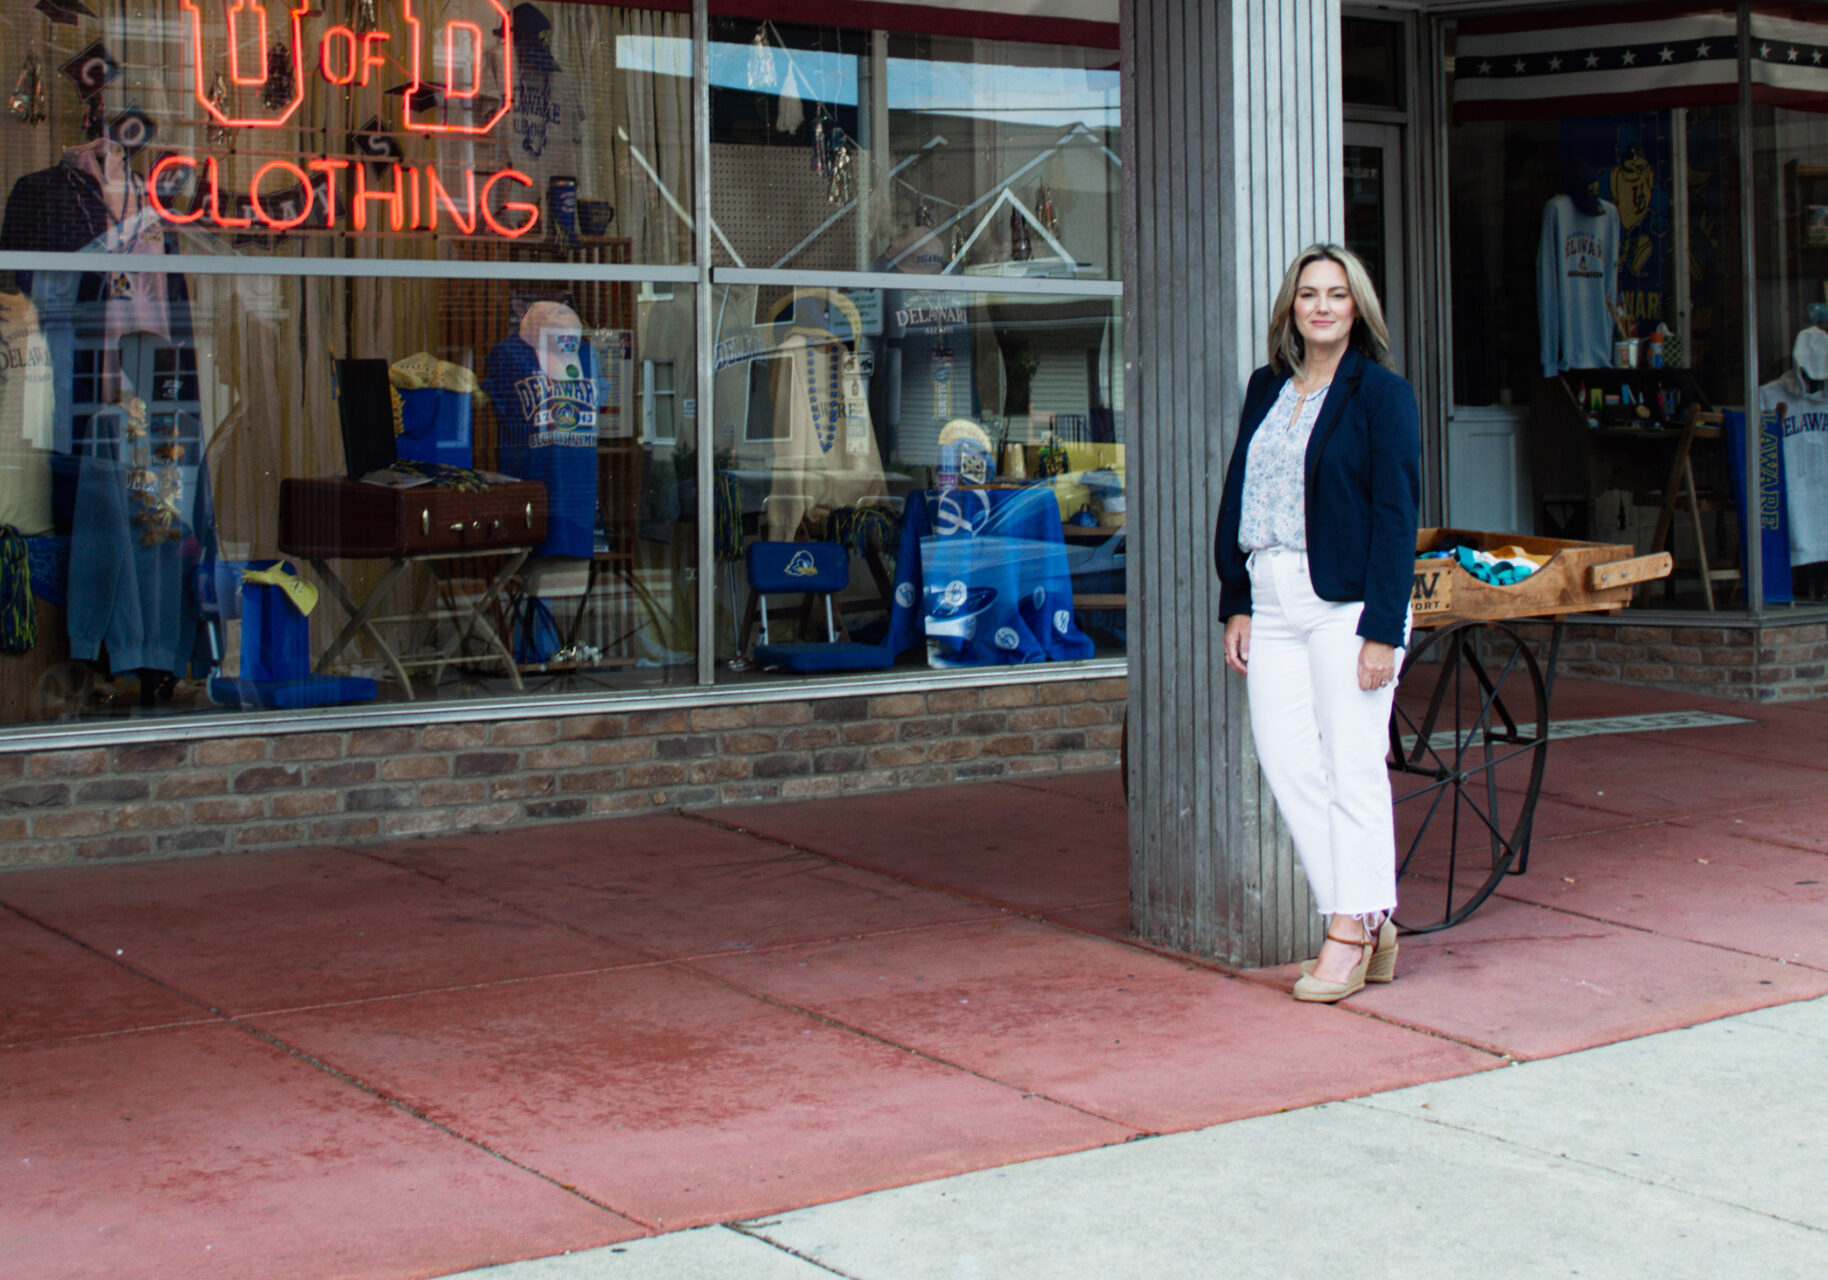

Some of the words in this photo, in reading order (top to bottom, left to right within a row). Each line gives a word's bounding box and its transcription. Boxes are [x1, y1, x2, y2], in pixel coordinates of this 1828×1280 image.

[320, 25, 391, 88] OF
[148, 155, 540, 238] CLOTHING
[1411, 600, 1440, 611] ORT
